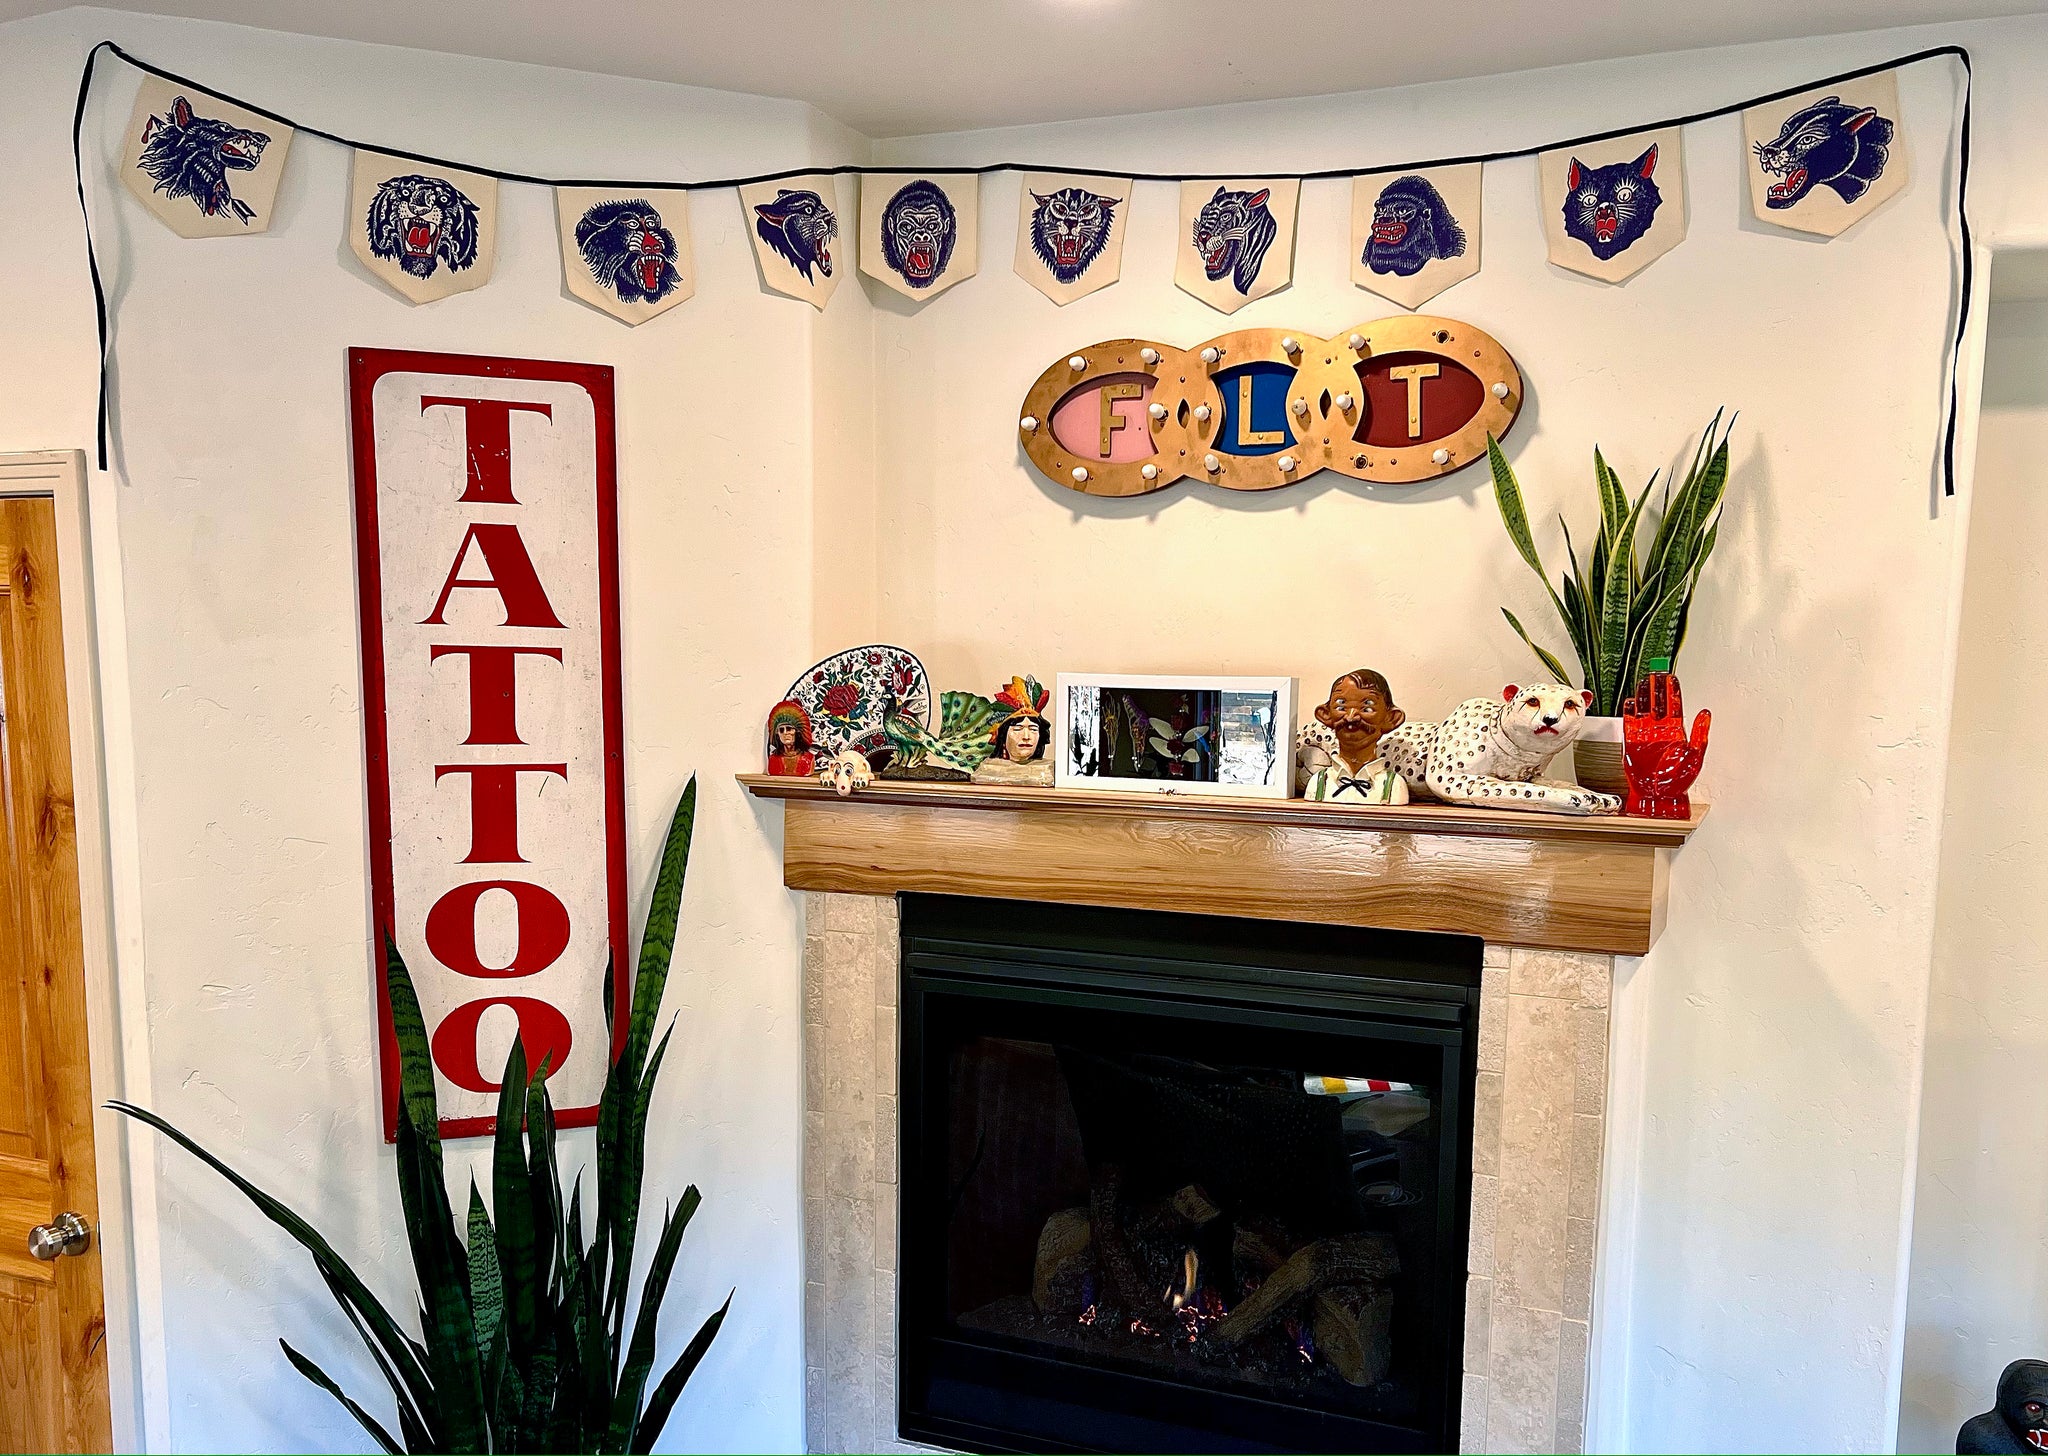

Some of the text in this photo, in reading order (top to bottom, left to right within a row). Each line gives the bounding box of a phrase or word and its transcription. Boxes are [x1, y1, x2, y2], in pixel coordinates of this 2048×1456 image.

[1100, 363, 1440, 457] F L T
[414, 395, 573, 1094] TATTOO
